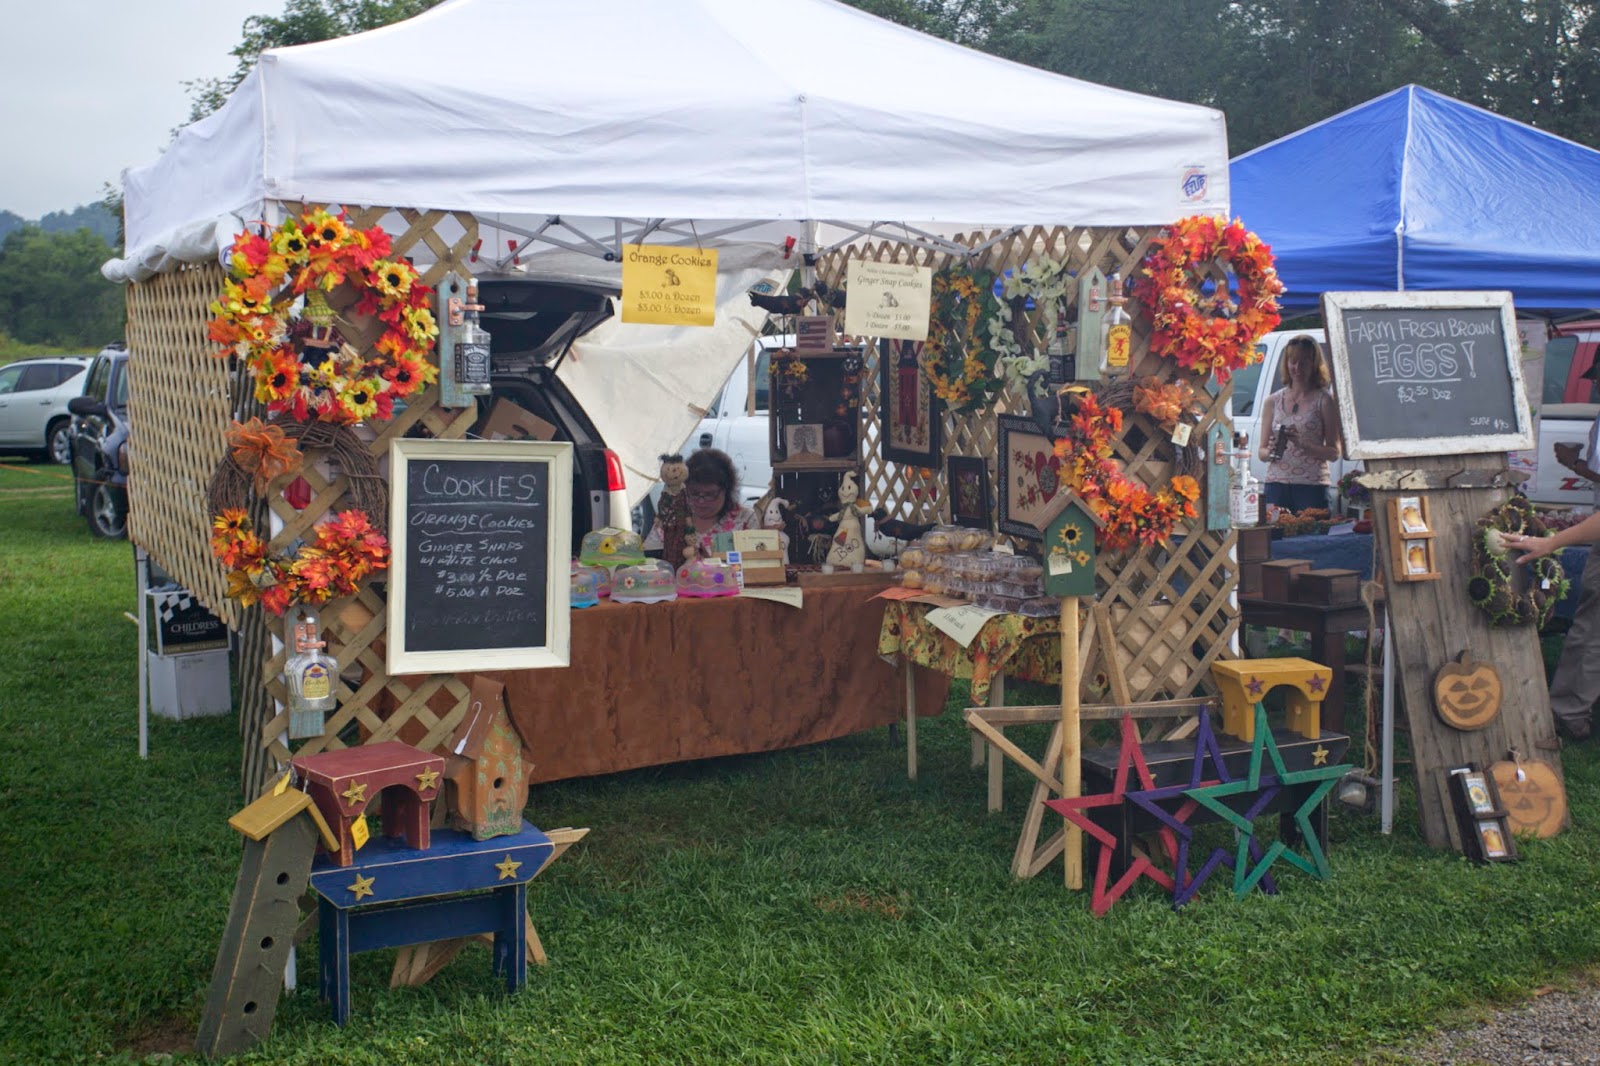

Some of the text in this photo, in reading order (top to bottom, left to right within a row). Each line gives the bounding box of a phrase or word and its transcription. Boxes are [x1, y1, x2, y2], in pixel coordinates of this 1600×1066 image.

[630, 252, 711, 266] Orange Cookies
[857, 275, 922, 289] Ginger Snap Cookies
[673, 292, 700, 302] Dozen
[674, 305, 701, 314] Dozen
[872, 312, 890, 320] Dozen
[1346, 316, 1496, 344] FARM FRESH BROWN
[418, 539, 524, 556] GINGER SNAPS
[435, 585, 475, 597] $5.00
[496, 586, 524, 596] DOZ
[171, 621, 218, 633] CHILDRESS
